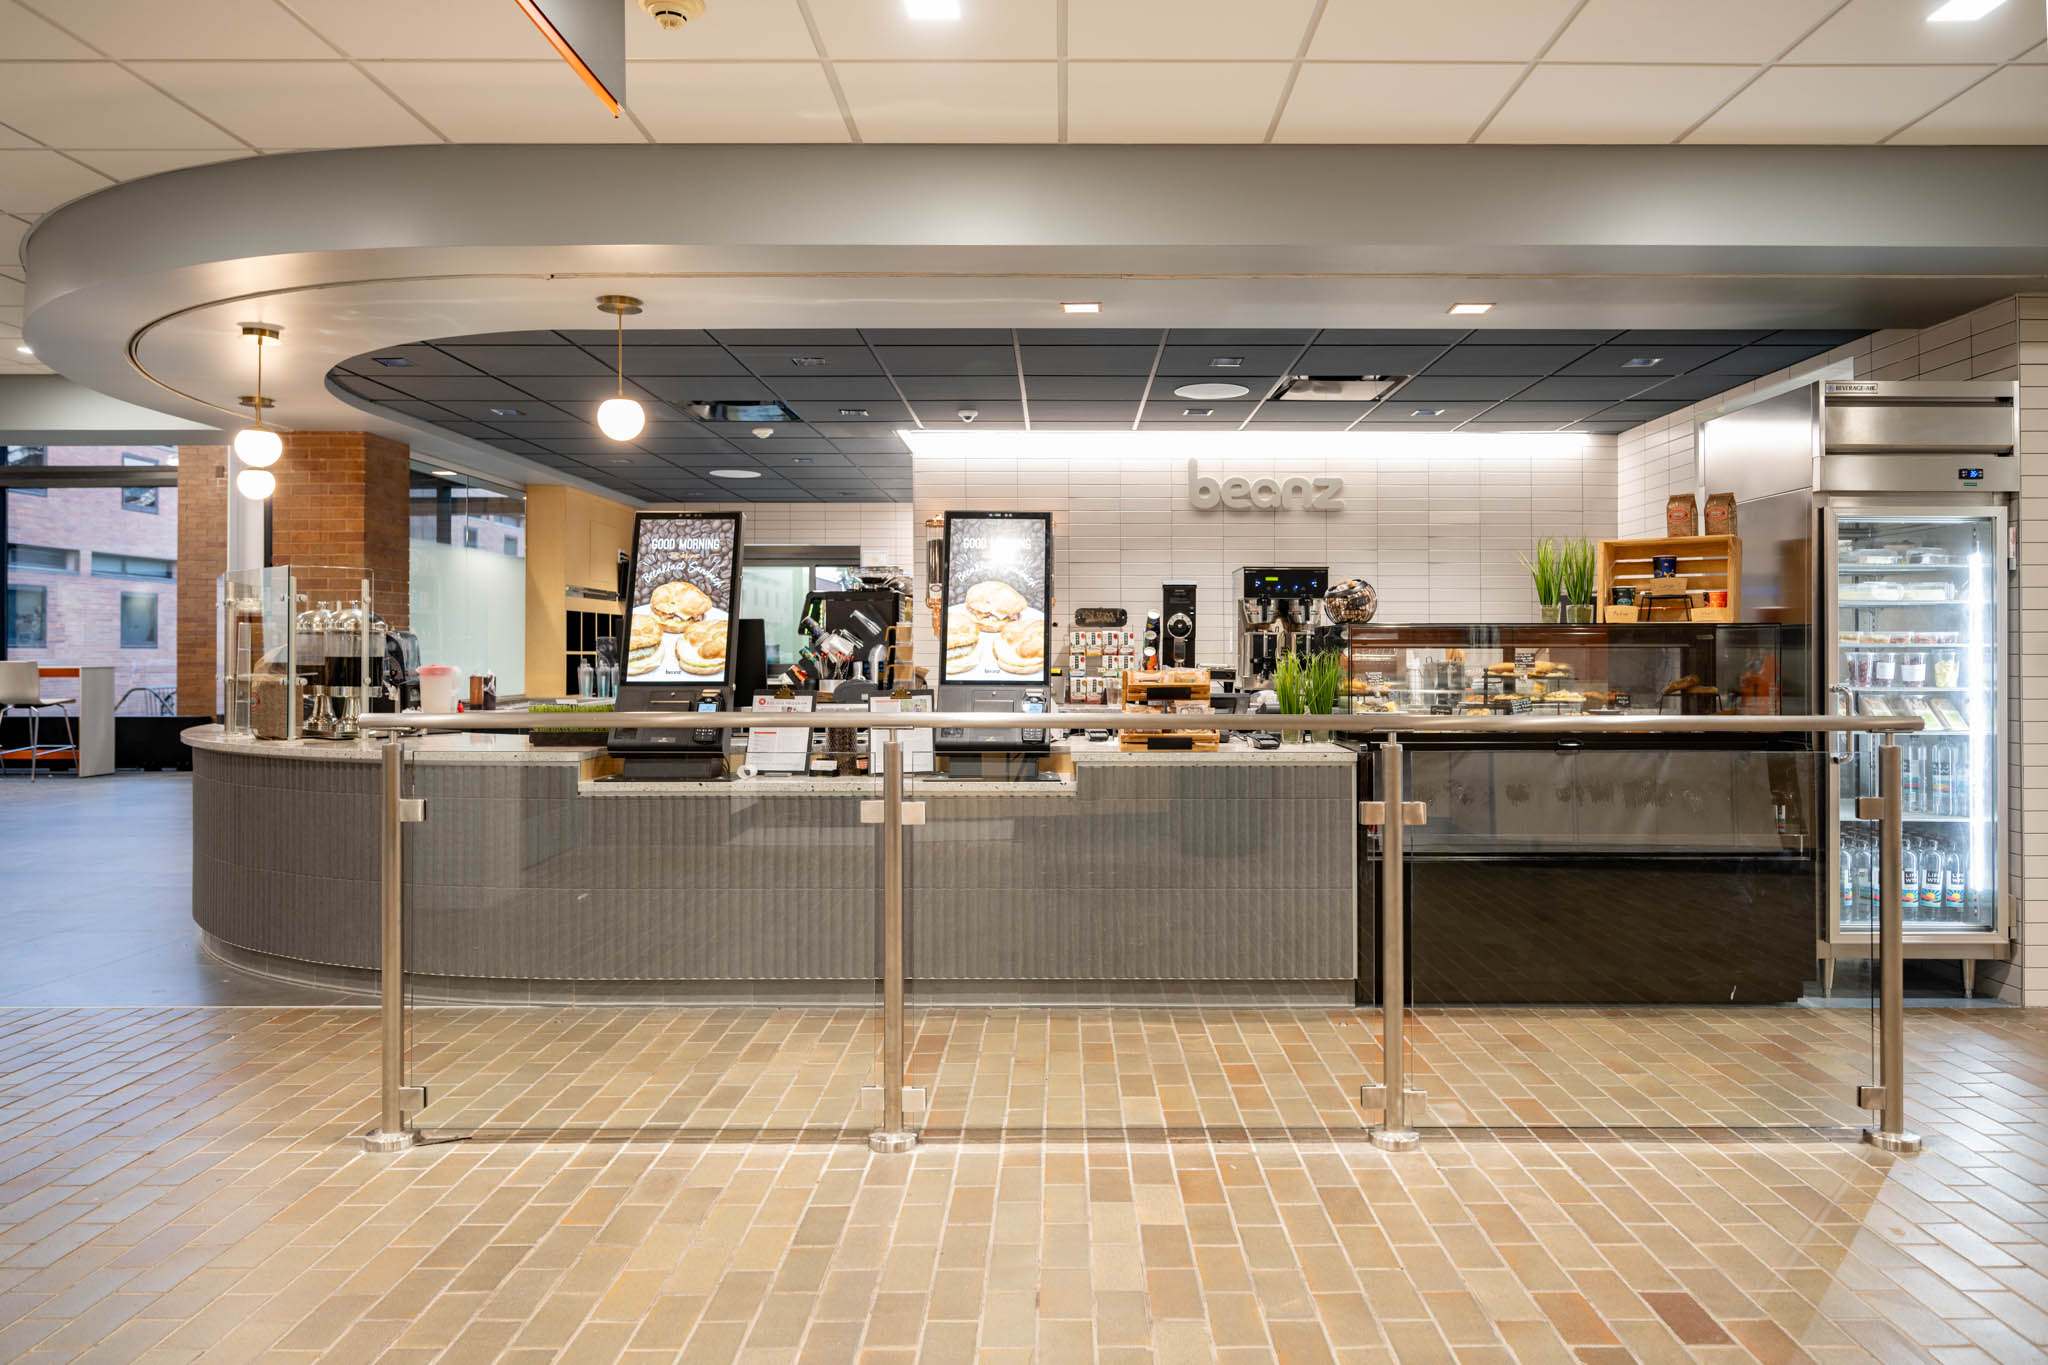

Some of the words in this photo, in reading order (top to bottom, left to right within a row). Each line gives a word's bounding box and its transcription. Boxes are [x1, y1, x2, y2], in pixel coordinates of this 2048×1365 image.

[1188, 457, 1344, 512] beanz
[651, 538, 675, 550] GOOD
[679, 538, 720, 550] MORNING
[642, 561, 686, 583] Breakfast
[687, 561, 726, 588] Sandwich
